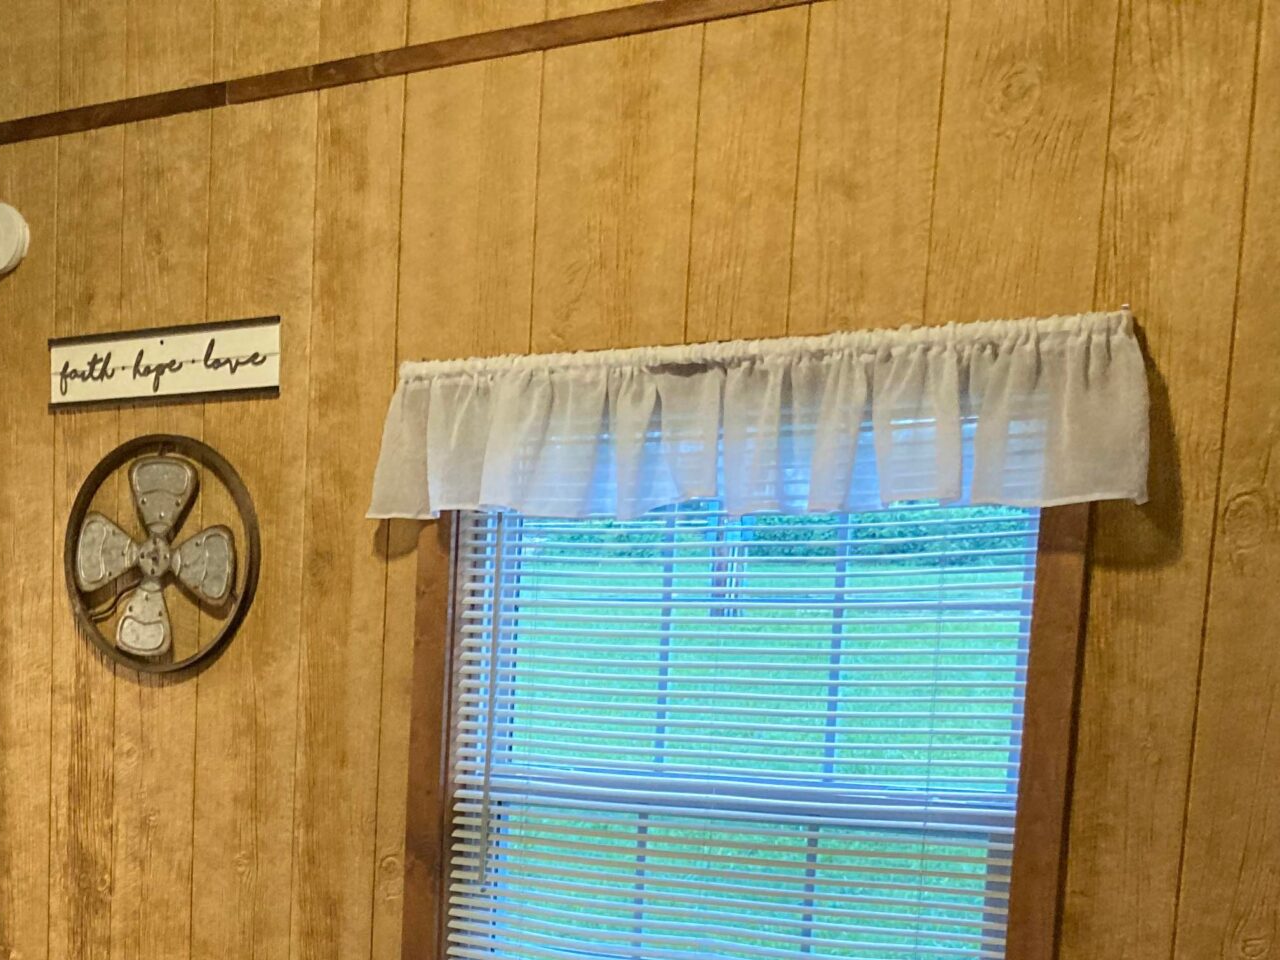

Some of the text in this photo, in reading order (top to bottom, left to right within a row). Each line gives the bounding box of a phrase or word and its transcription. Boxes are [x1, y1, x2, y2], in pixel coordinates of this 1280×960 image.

[58, 338, 267, 396] faith hope love
